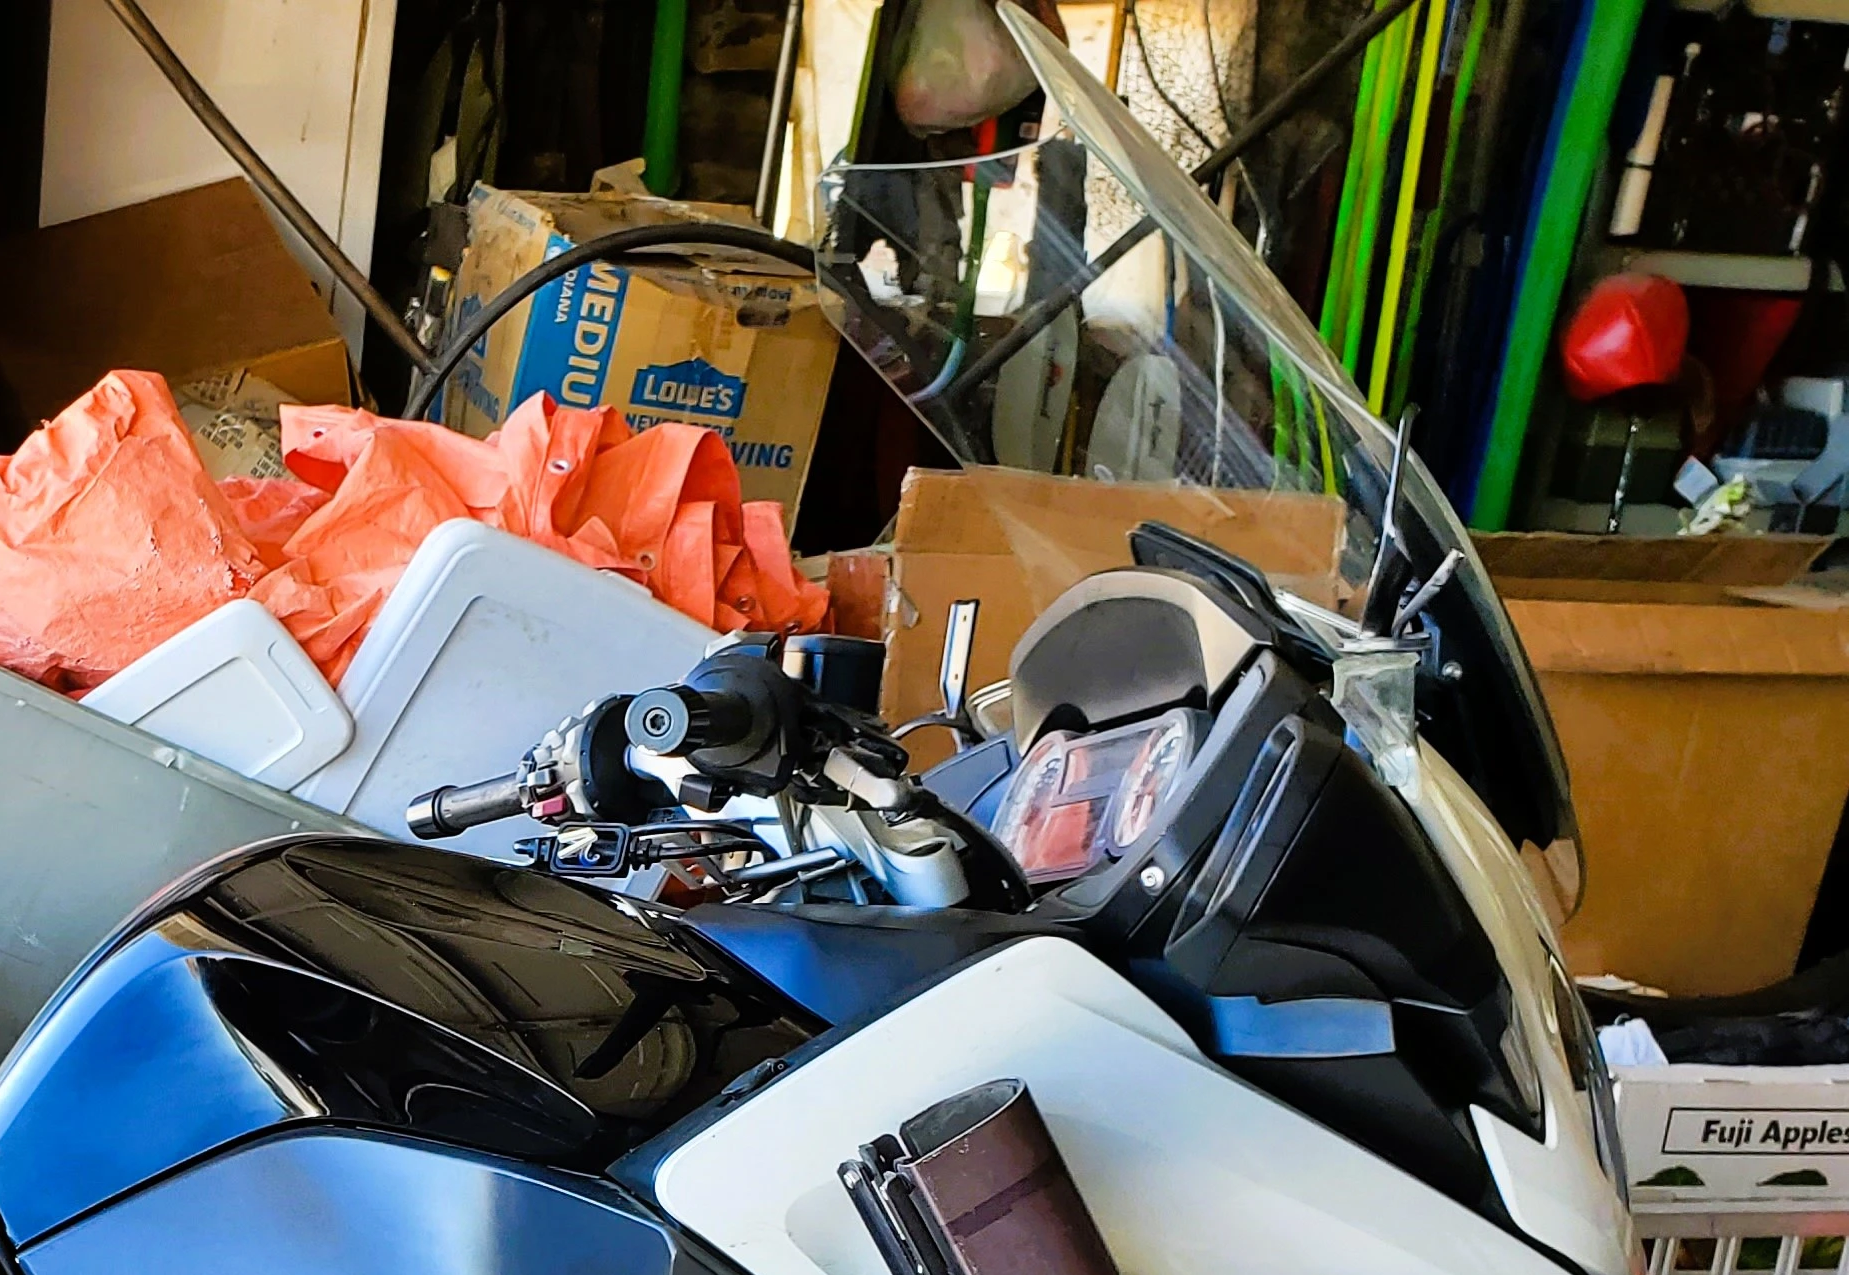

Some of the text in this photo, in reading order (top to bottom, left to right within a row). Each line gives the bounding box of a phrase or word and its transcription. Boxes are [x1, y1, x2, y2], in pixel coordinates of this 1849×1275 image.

[554, 269, 578, 323] DIANA
[561, 261, 621, 405] MEDIU
[643, 374, 735, 411] LOWE'S
[1701, 1118, 1849, 1150] Fuji Apples
